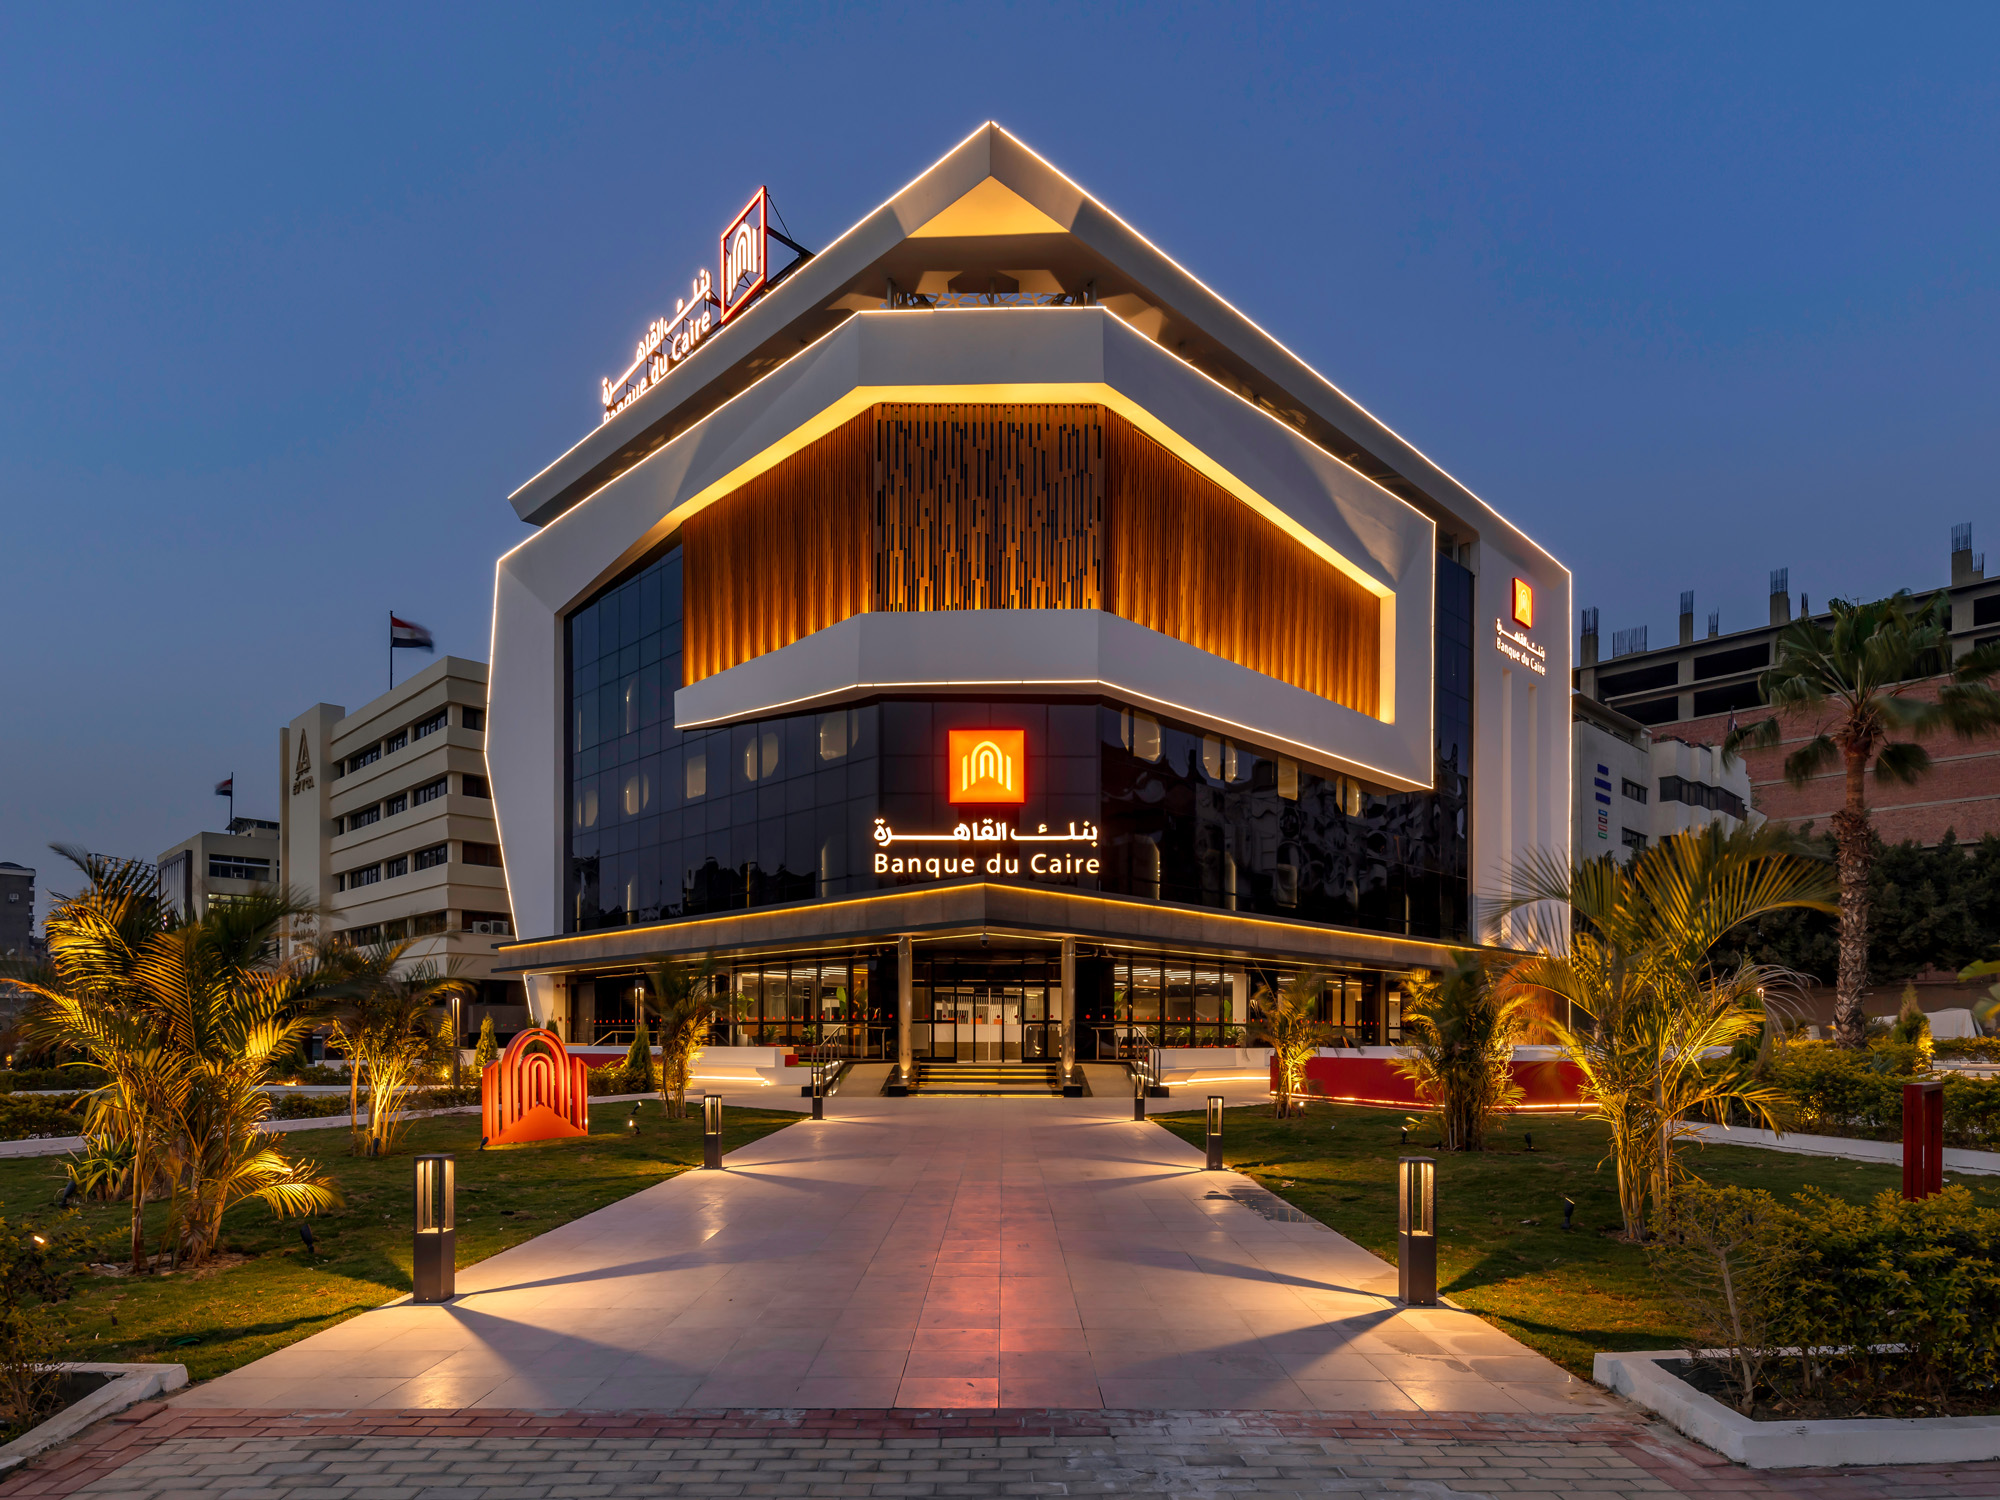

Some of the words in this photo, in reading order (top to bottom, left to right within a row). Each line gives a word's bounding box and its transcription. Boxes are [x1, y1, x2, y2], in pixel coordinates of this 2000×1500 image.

[651, 354, 669, 385] du
[671, 311, 711, 361] Caire
[1496, 638, 1520, 659] Banque
[1521, 652, 1529, 667] du
[1530, 658, 1546, 676] Caire
[873, 818, 1007, 847] القاهرة
[1010, 820, 1099, 848] بنك
[874, 853, 975, 878] Banque
[986, 853, 1019, 874] du
[1030, 853, 1100, 874] Caire
